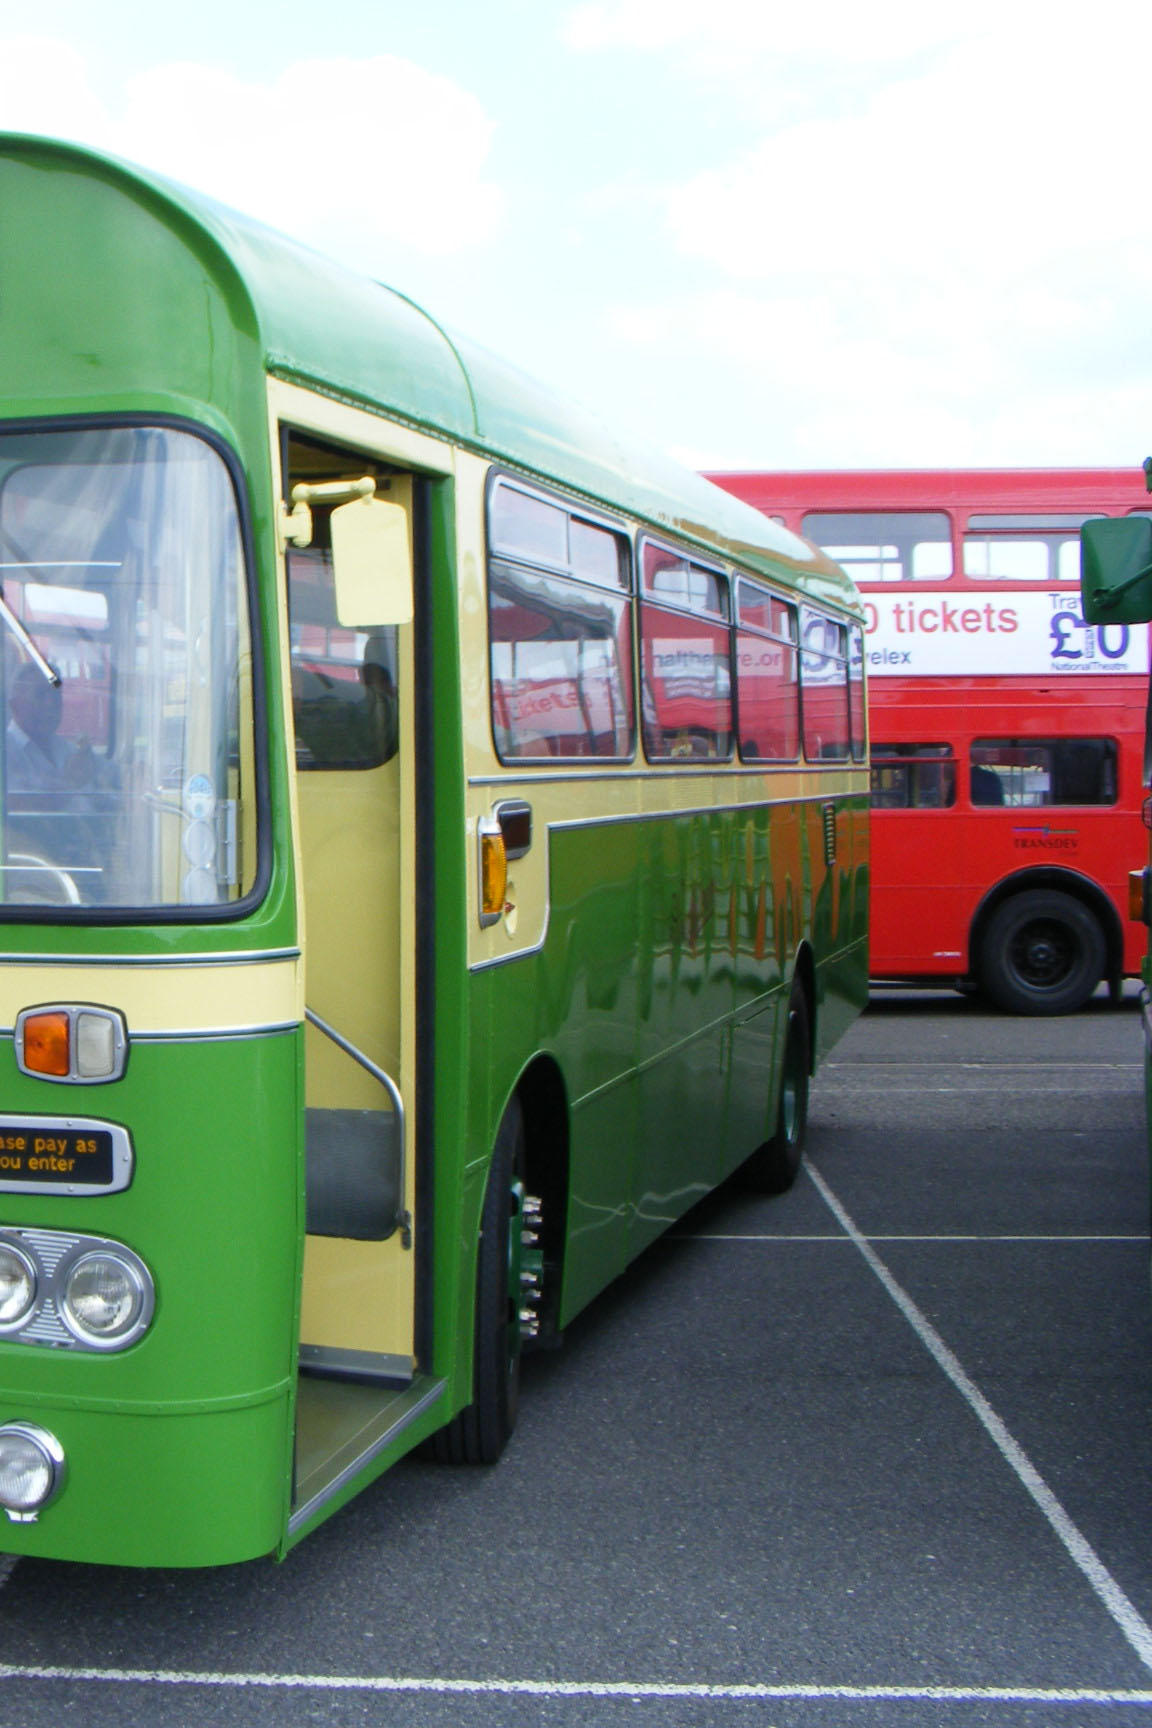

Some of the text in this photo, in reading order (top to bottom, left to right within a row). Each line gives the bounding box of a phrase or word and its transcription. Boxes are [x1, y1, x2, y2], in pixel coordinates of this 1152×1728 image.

[1048, 593, 1082, 609] Tra
[893, 601, 1018, 633] tickets
[867, 647, 912, 665] elex
[1014, 838, 1079, 849] TRANSDEV
[35, 1138, 67, 1155] pay
[76, 1139, 97, 1153] as
[28, 1156, 76, 1172] enter
